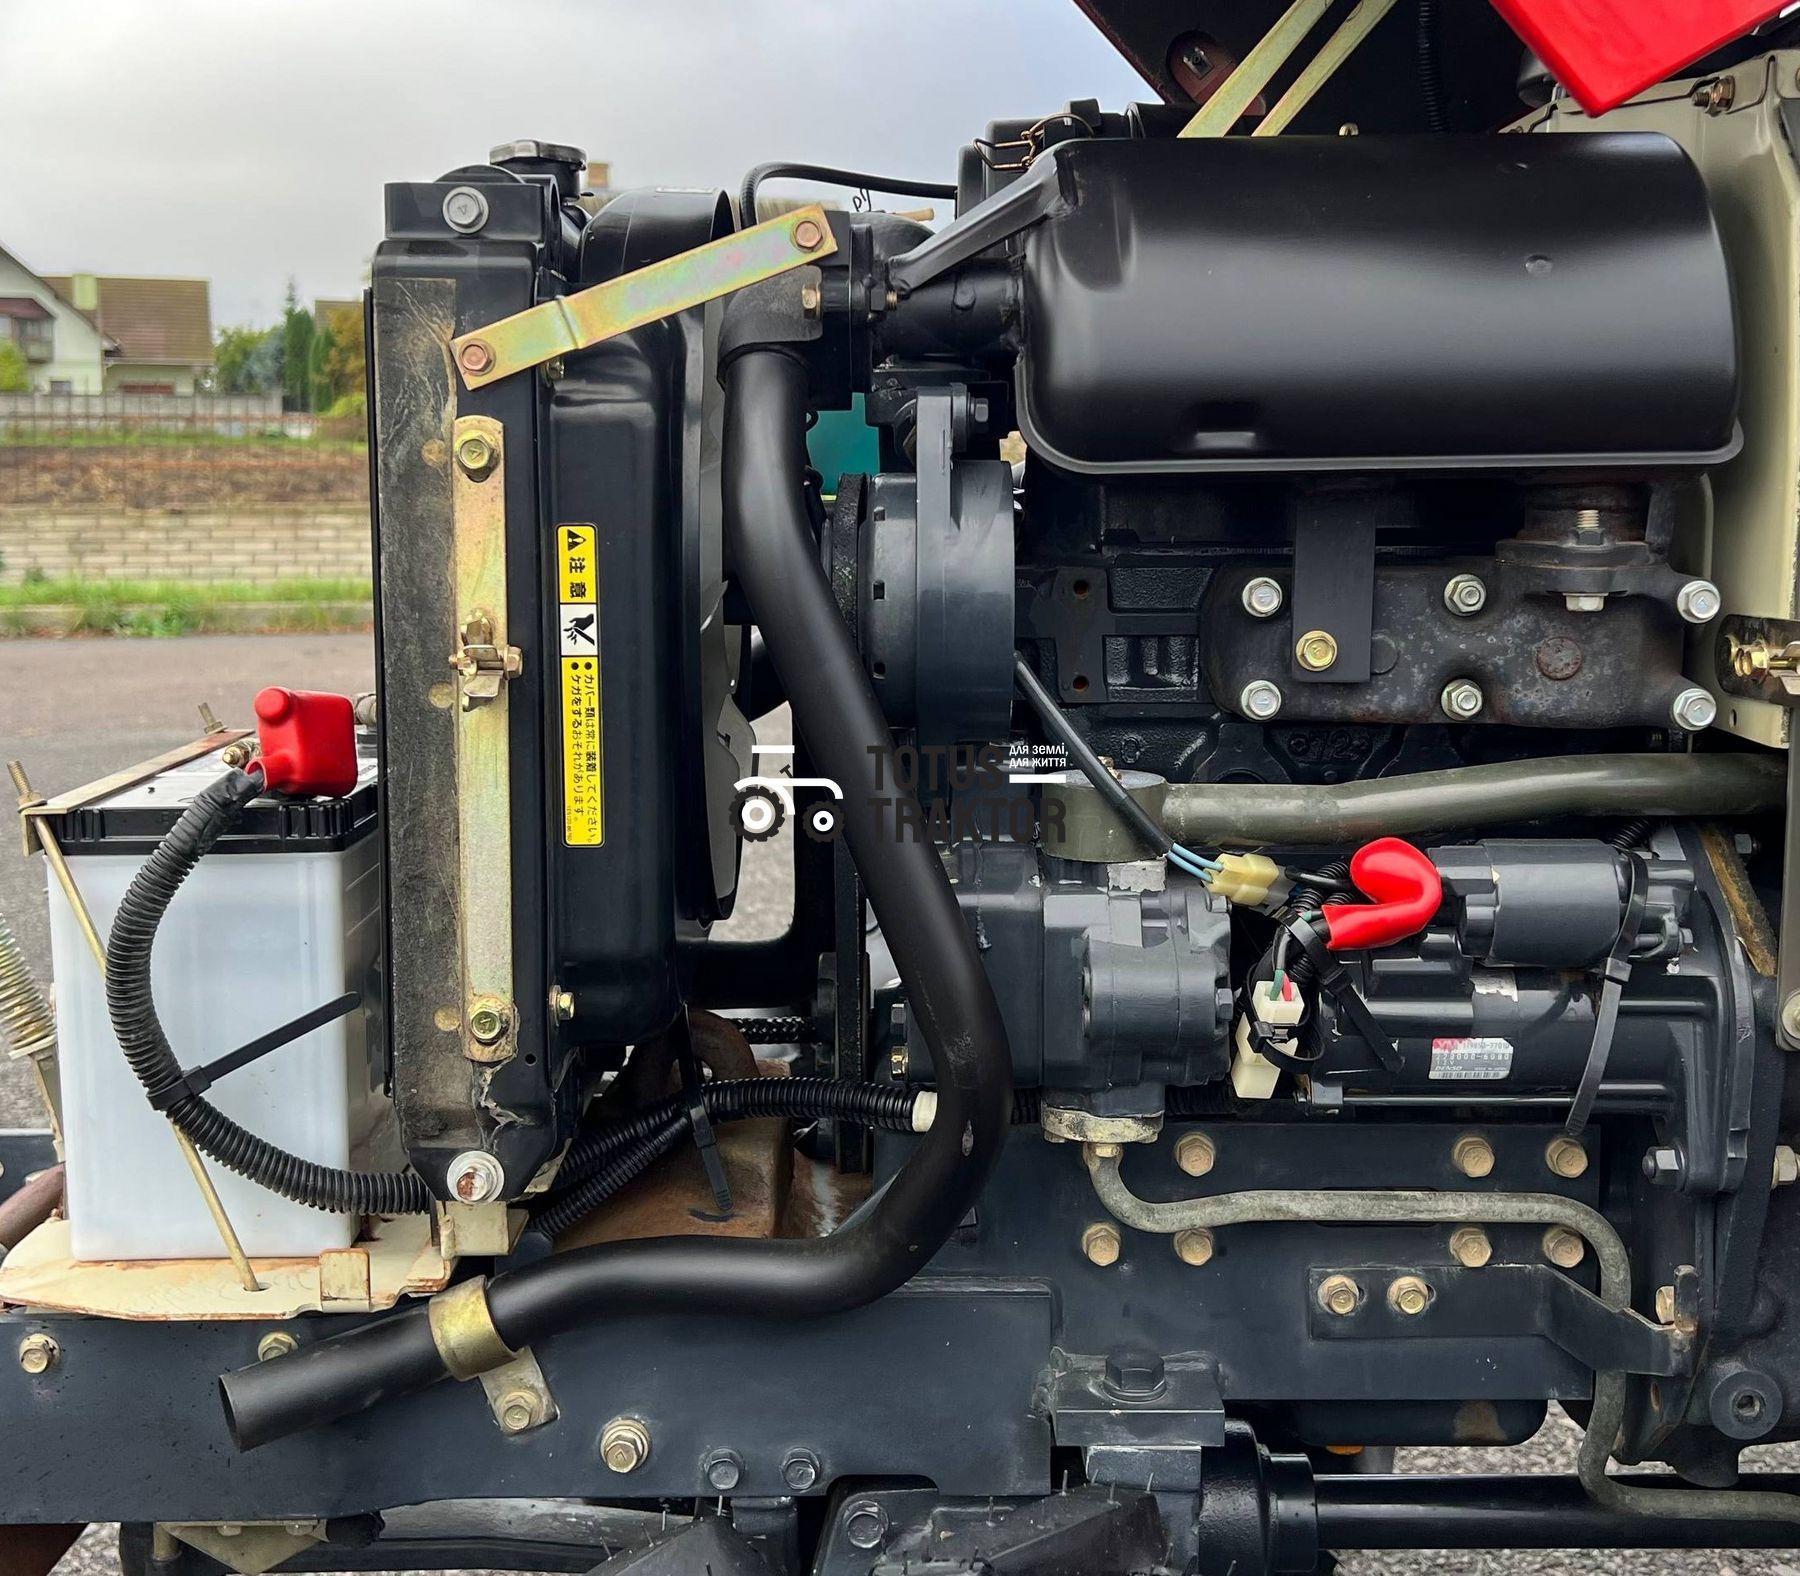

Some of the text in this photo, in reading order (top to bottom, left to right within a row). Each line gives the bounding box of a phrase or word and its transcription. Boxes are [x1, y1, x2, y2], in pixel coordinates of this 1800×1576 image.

[569, 556, 587, 598] 注意
[571, 674, 585, 822] ケガをするおそれがあります。
